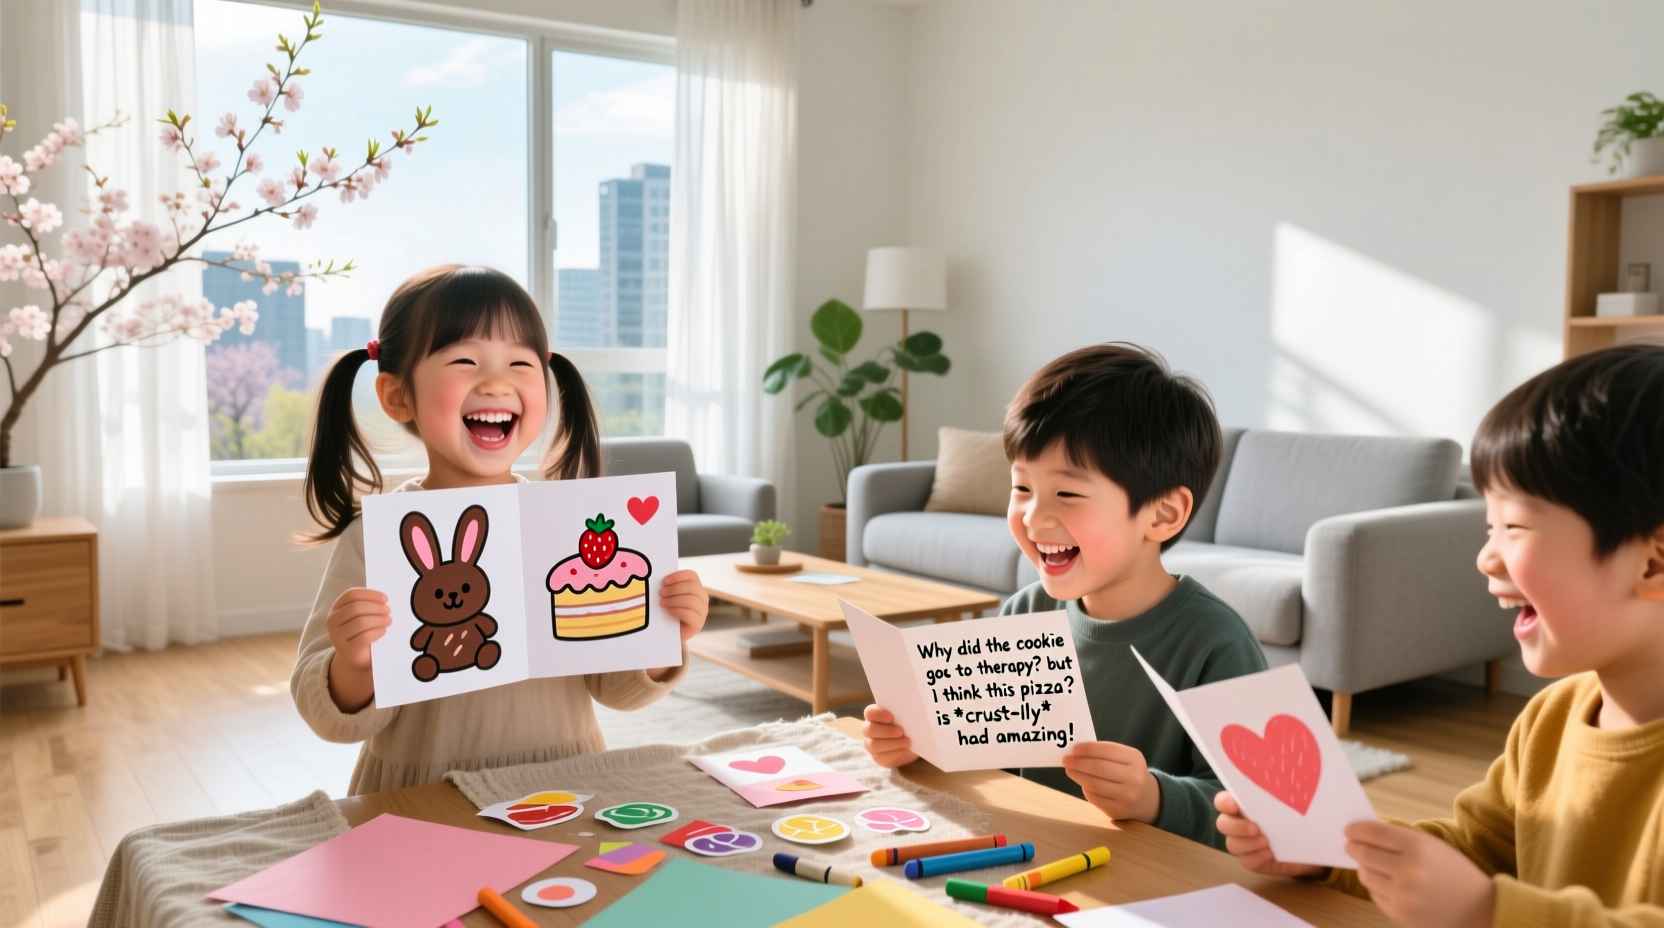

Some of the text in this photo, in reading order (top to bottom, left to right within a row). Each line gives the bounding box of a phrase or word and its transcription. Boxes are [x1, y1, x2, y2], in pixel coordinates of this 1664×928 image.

[917, 633, 1064, 662] Why did the cookie
[955, 664, 972, 676] to
[977, 656, 1041, 676] therapy?
[1047, 656, 1072, 670] but
[943, 684, 982, 701] think
[986, 683, 1015, 697] this
[1020, 676, 1074, 701] pizza?
[936, 711, 950, 725] is
[957, 723, 1073, 748] had amazing!
